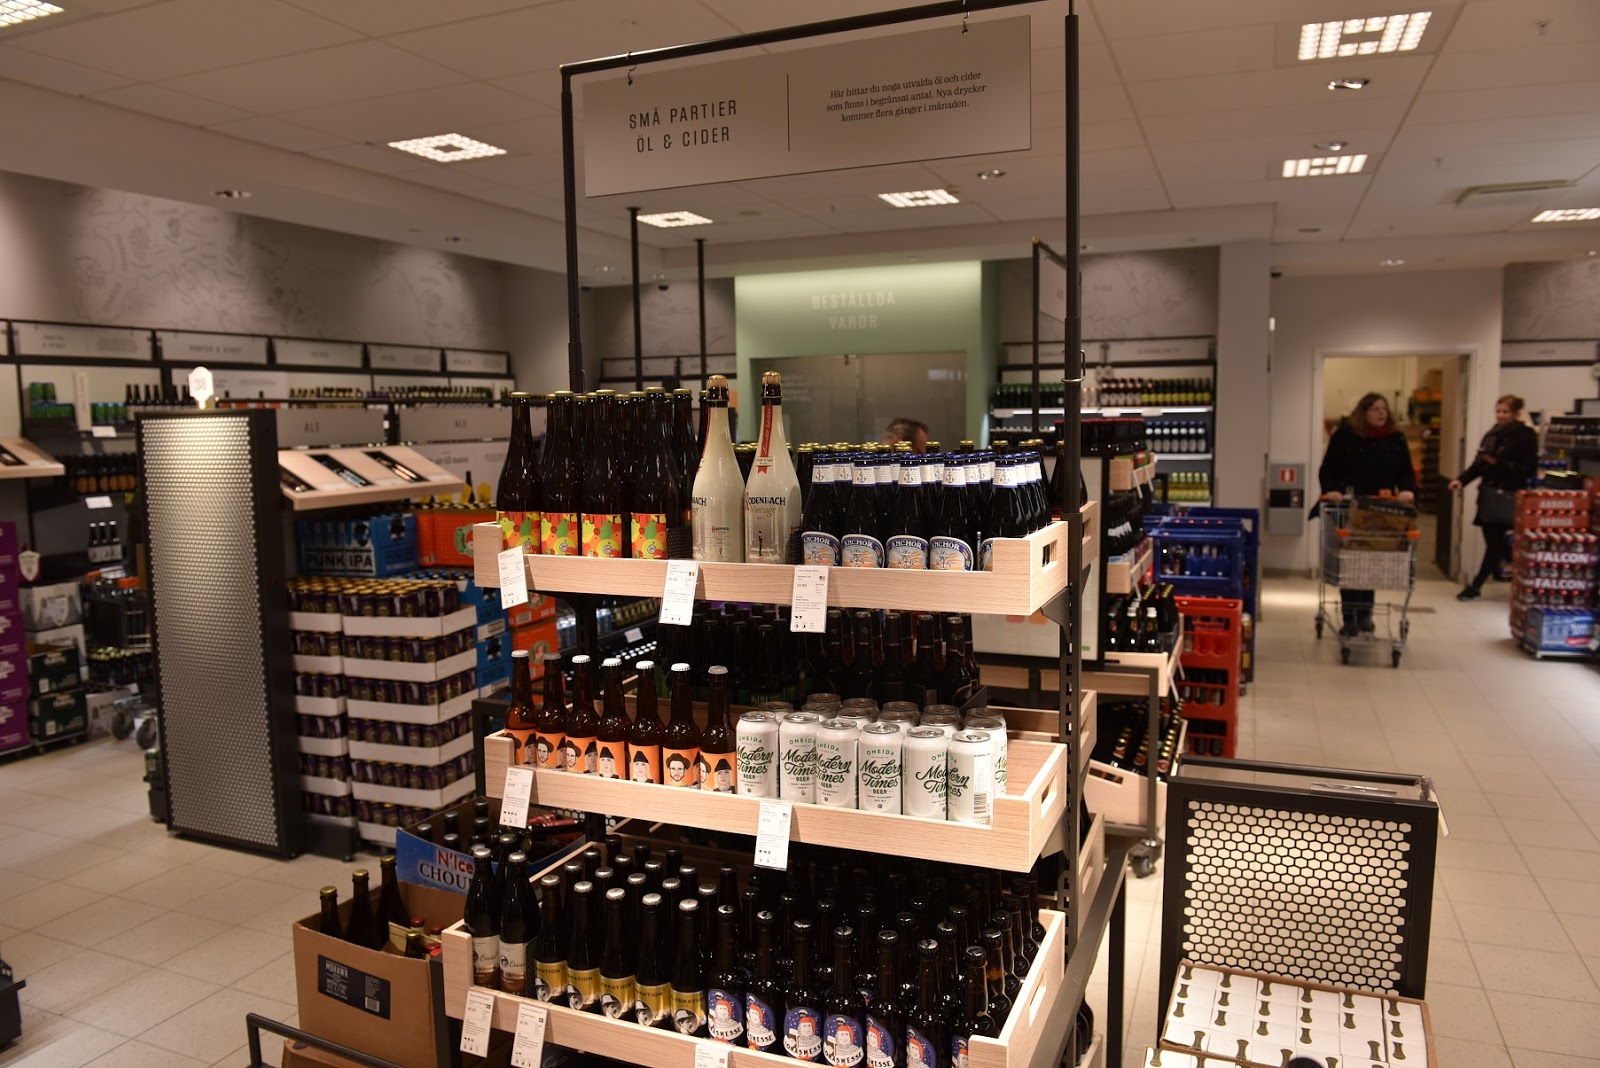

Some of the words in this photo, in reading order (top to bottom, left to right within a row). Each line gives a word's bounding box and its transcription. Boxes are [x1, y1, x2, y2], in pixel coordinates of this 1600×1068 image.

[830, 89, 845, 99] Här
[846, 86, 869, 97] hittar
[870, 84, 880, 93] du
[882, 82, 901, 93] noga
[902, 77, 933, 89] utvalda
[934, 75, 942, 85] öl
[944, 74, 959, 84] och
[960, 71, 982, 82] cider
[826, 103, 843, 112] som
[844, 99, 864, 110] finns
[870, 94, 909, 108] begränsat
[910, 91, 934, 101] antal.
[936, 88, 953, 99] Nya
[954, 84, 987, 98] drycker
[629, 106, 661, 130] SMÅ
[670, 99, 737, 124] PARTIER
[841, 111, 874, 122] kommer
[875, 108, 894, 119] flera
[894, 105, 922, 117] gånger
[928, 99, 970, 112] månaden.
[636, 134, 654, 153] ÖL
[663, 133, 673, 150] &
[682, 126, 730, 148] CIDER
[829, 313, 878, 331] VAROR
[194, 378, 208, 390] 38
[304, 421, 320, 434] ALE
[454, 419, 467, 430] ALE
[844, 537, 873, 548] ANCHOR
[891, 538, 922, 549] ANCHOR
[931, 539, 961, 551] ANCHOR
[305, 554, 346, 568] PUNK
[348, 553, 374, 568] IPA
[1536, 551, 1590, 564] FALCON
[1534, 577, 1587, 590] FALCON
[866, 748, 895, 756] ONEIDA
[784, 762, 817, 776] Time
[861, 772, 899, 789] Times
[419, 862, 472, 890] CHOU
